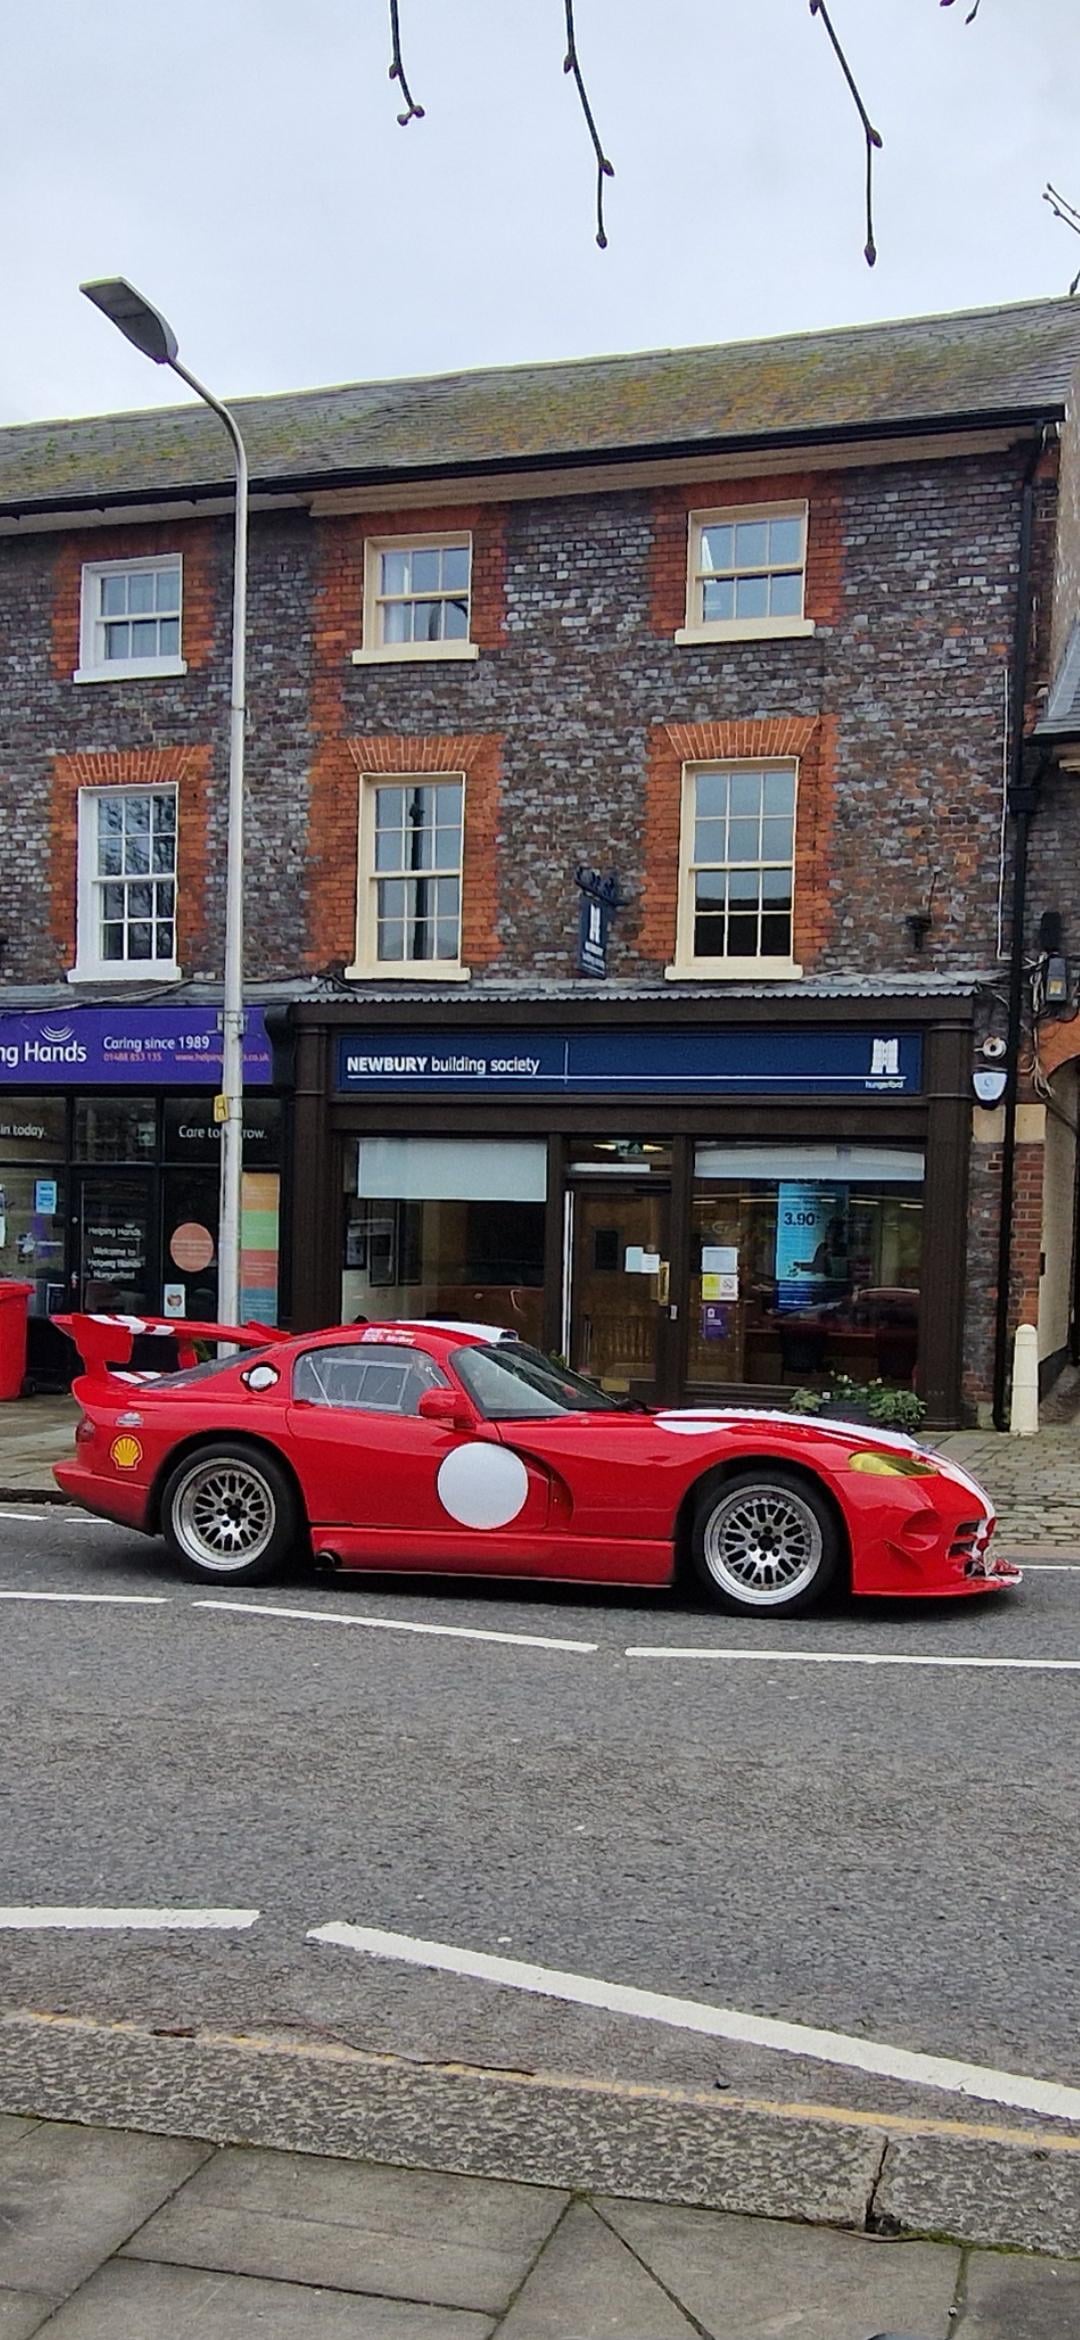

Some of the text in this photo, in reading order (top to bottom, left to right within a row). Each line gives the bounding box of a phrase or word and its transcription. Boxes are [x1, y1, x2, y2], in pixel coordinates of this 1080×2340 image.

[24, 1040, 87, 1062] Hands
[103, 1035, 210, 1053] Caring since 1989
[347, 1056, 540, 1075] NEWBURY building society
[13, 1122, 47, 1139] today.
[178, 1125, 267, 1139] Care torow.
[88, 1227, 116, 1238] Helping
[92, 1246, 126, 1256] Welcome
